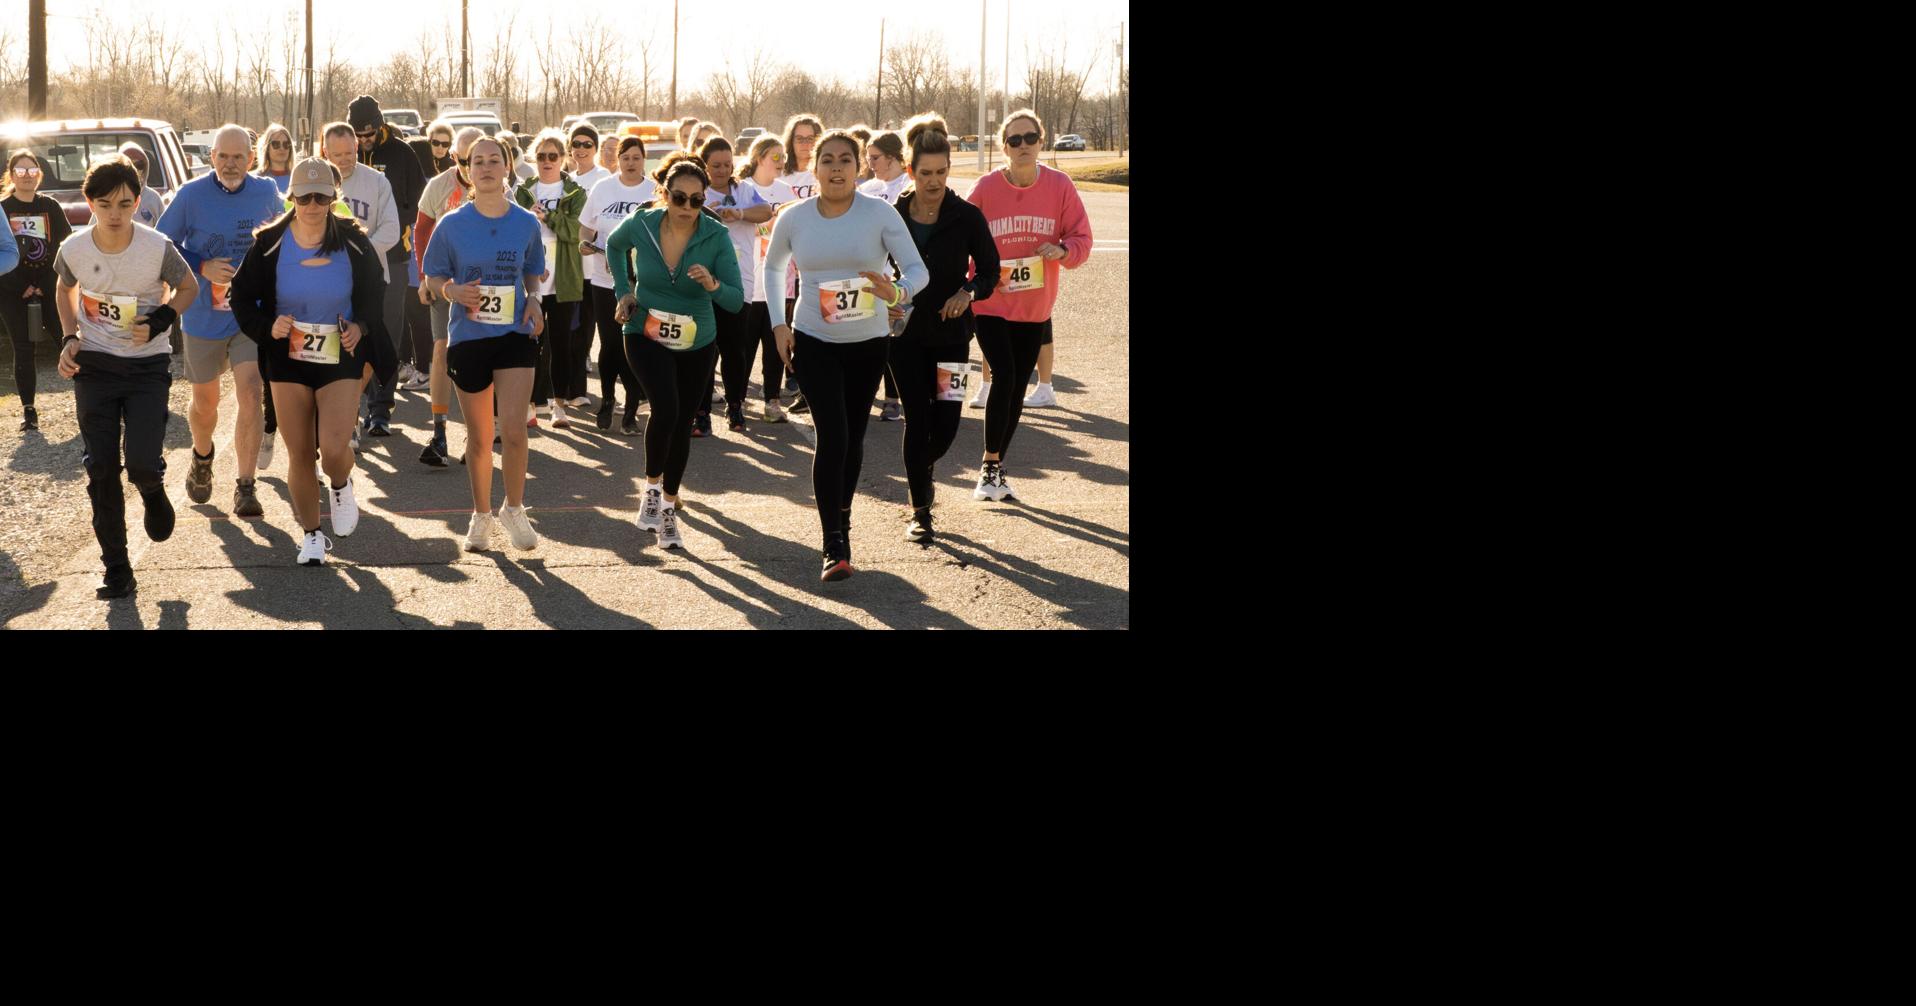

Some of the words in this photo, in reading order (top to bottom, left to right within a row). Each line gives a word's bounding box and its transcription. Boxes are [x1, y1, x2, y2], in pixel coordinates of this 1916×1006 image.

[21, 221, 37, 230] 12
[1013, 215, 1032, 233] CITY
[1032, 216, 1056, 236] BEACH
[1002, 236, 1038, 245] FLORIDA
[496, 251, 518, 262] 2025
[1010, 267, 1030, 282] 46
[480, 296, 502, 313] 23
[836, 290, 859, 310] 37
[98, 302, 121, 321] 53
[659, 321, 682, 339] 55
[303, 333, 327, 351] 27
[950, 373, 968, 390] 54
